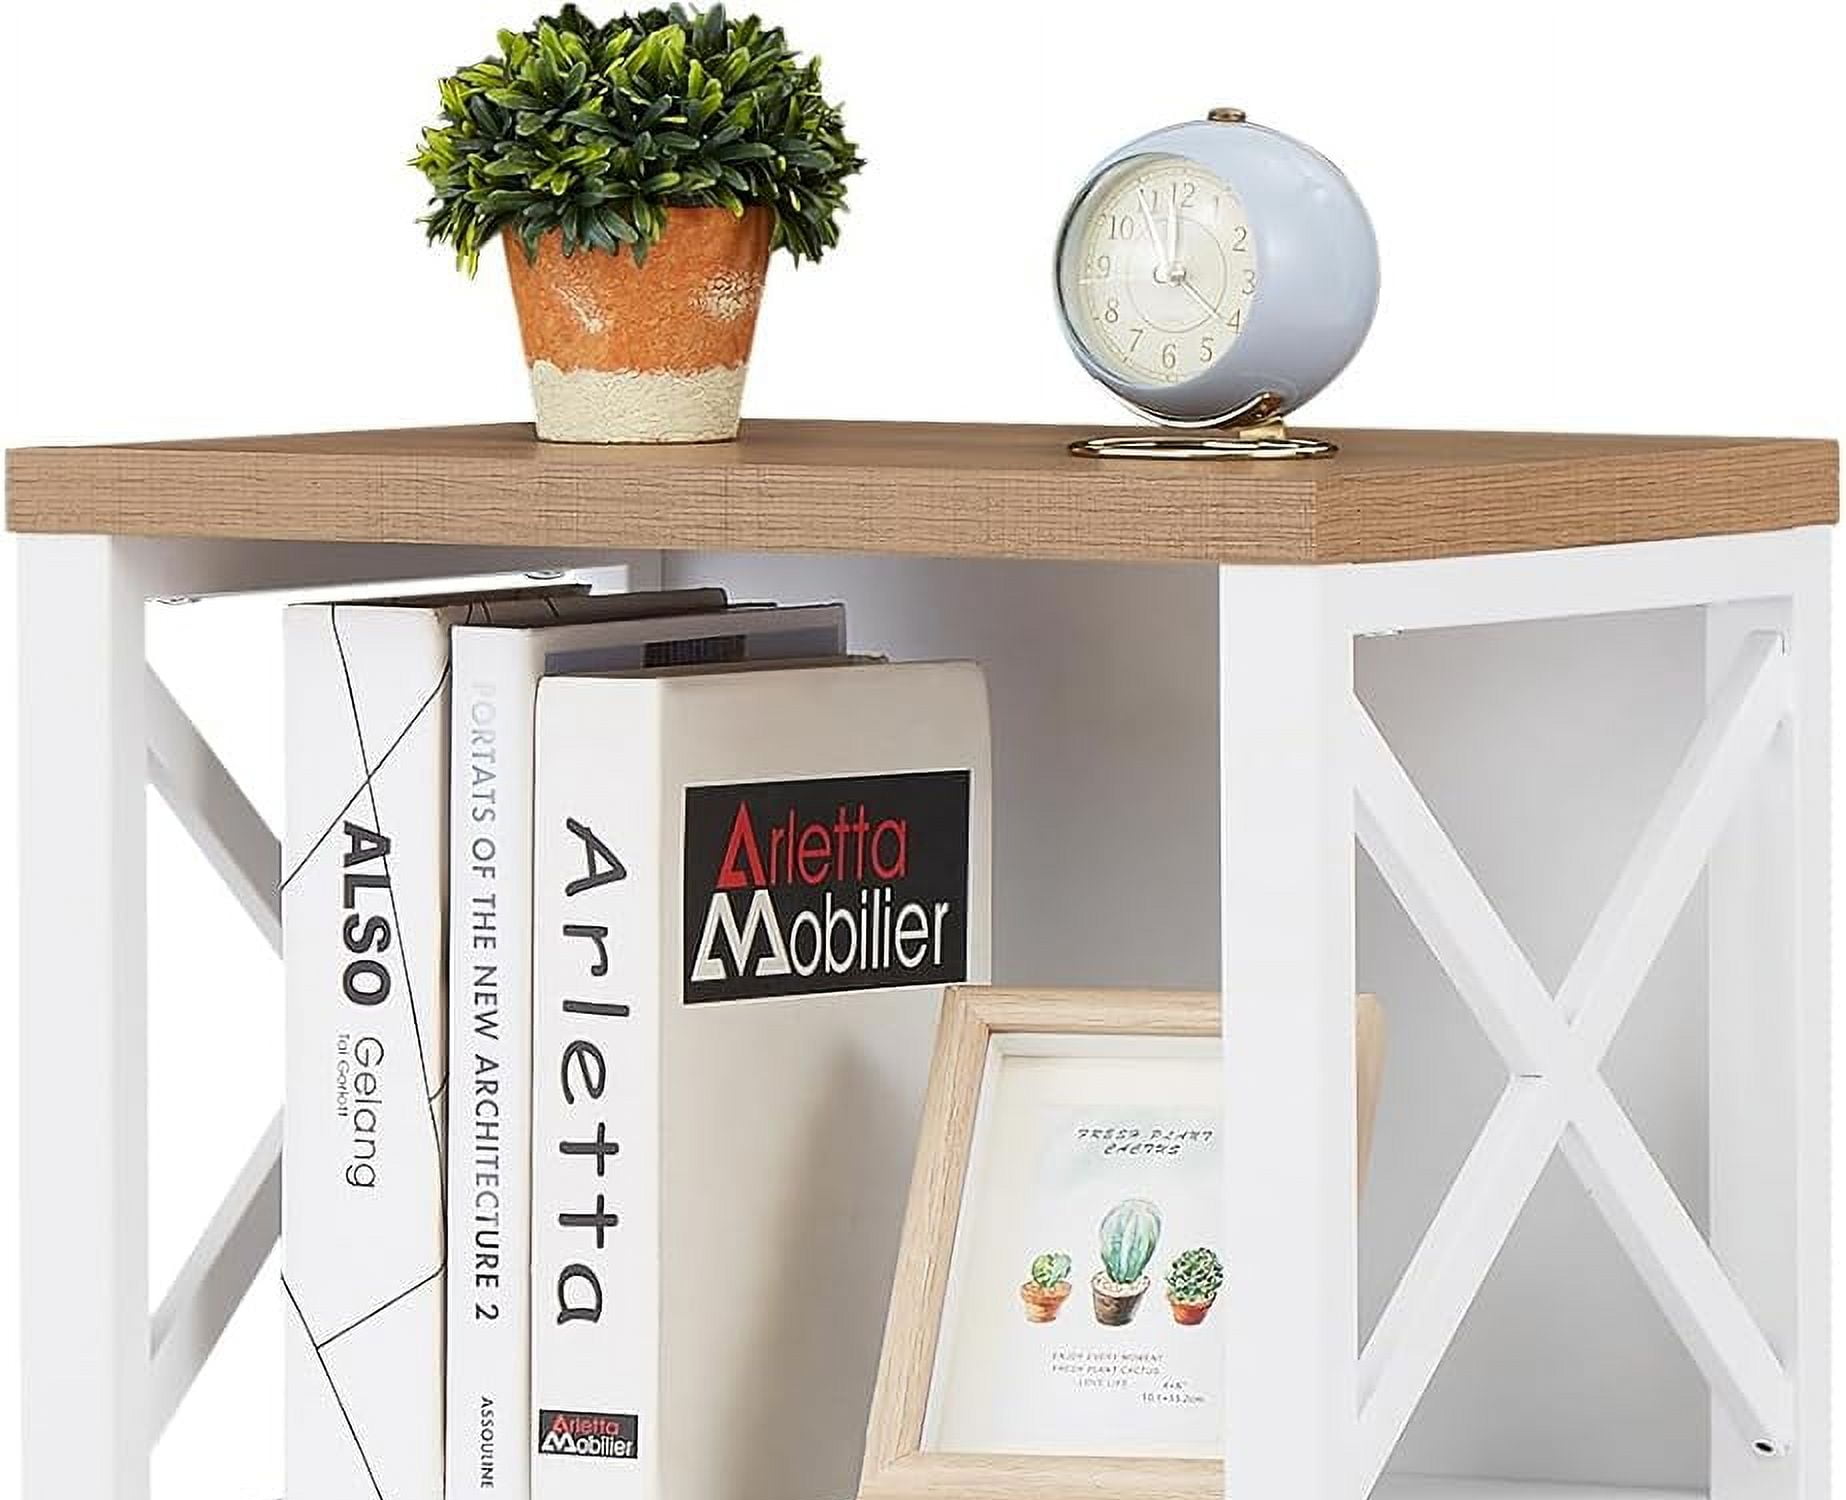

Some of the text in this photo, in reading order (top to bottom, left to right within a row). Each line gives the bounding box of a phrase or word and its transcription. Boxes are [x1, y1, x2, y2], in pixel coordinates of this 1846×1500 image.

[1171, 182, 1196, 208] 12
[1109, 214, 1135, 240] 10
[1232, 226, 1247, 252] 2
[1097, 255, 1111, 279] 9
[1242, 271, 1257, 296] 3
[1104, 298, 1120, 323] 8
[1226, 308, 1241, 334] 4
[1129, 328, 1144, 352] 7
[1200, 337, 1213, 363] 5
[1161, 343, 1177, 369] 6
[716, 801, 908, 889] Arletta
[690, 886, 950, 982] Mobilier
[342, 820, 392, 1188] ALSO Gelang
[471, 682, 500, 1321] PORTATS OF THE NEW ARCHITECTURE 2
[557, 816, 631, 1325] Arletta
[552, 1413, 620, 1436] Arletta
[480, 1396, 495, 1489] ASSOULINE
[541, 1430, 634, 1457] Mobilier
